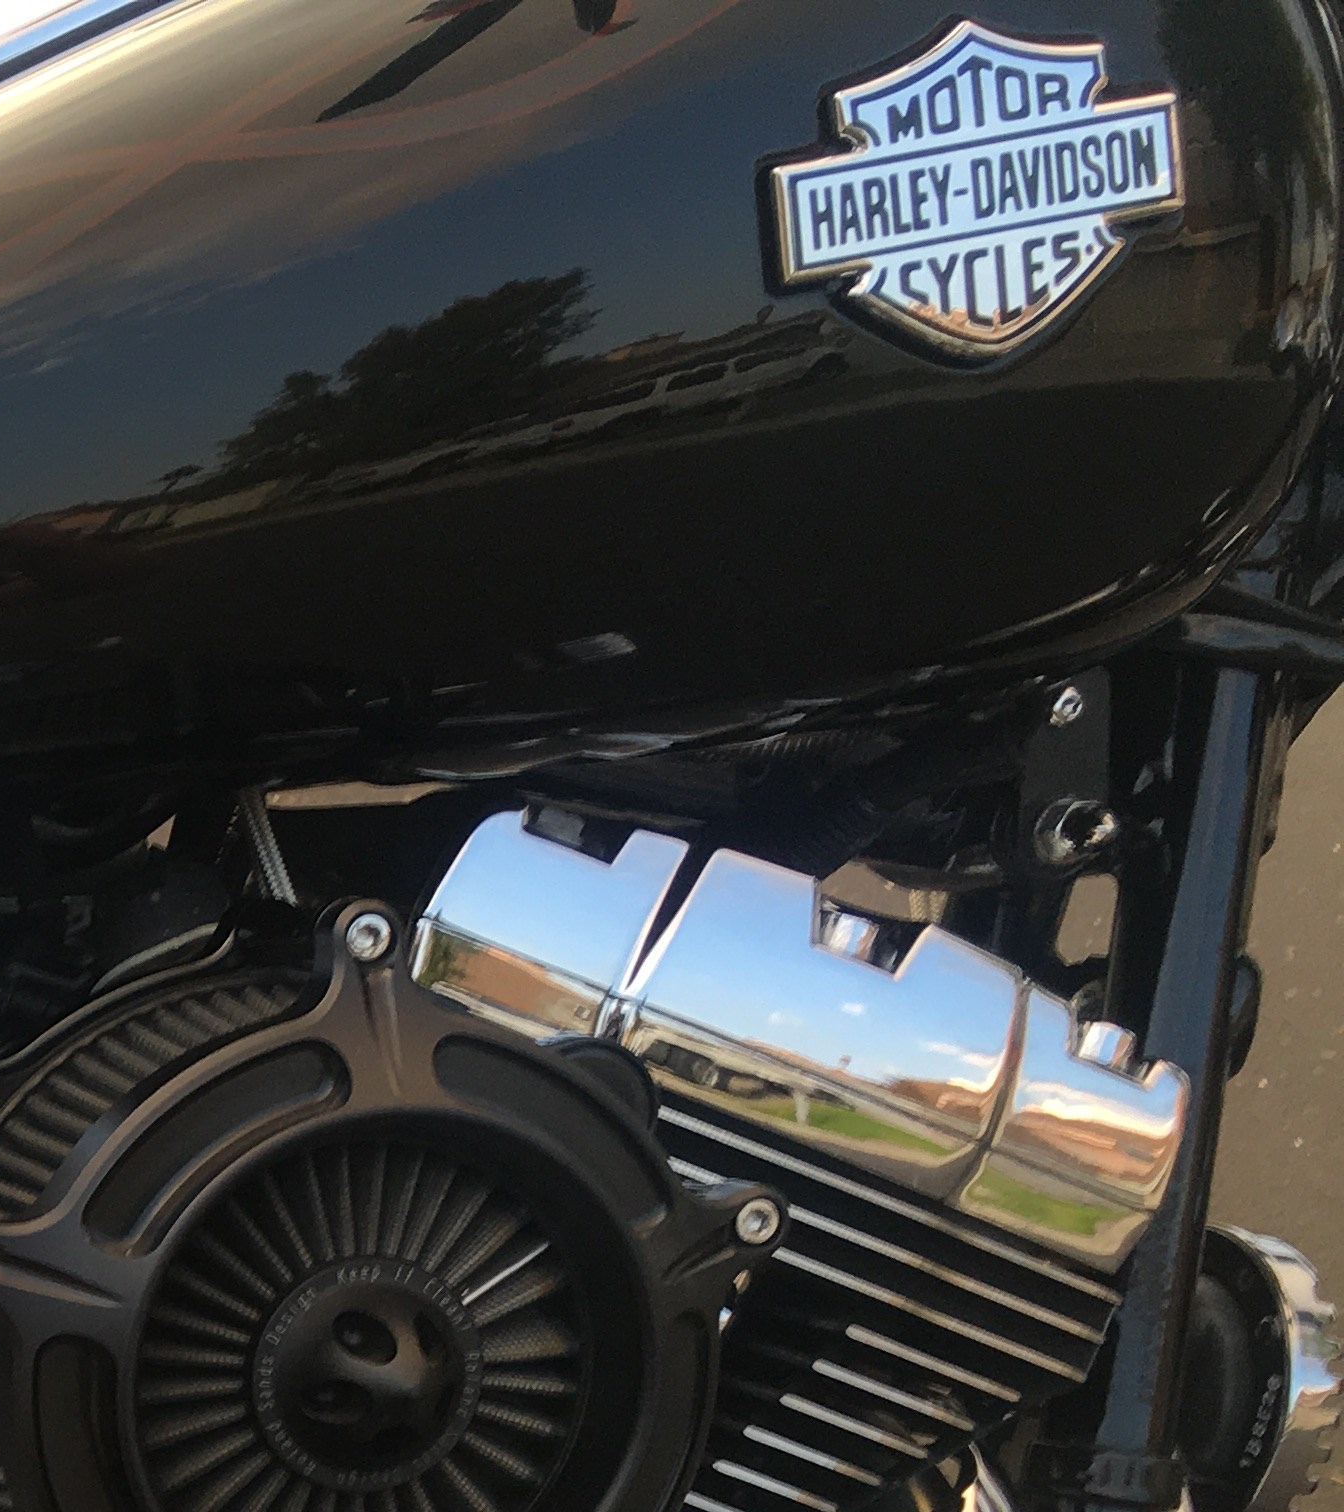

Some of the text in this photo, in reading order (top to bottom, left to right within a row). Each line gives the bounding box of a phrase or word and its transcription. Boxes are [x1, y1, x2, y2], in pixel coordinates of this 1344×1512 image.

[887, 56, 1071, 145] MOTOR
[808, 124, 1158, 251] HARLEY-DAVIDSON
[900, 228, 1081, 328] CYCLES
[336, 1264, 382, 1285] Keep
[257, 1287, 318, 1476] Roland Sands Design
